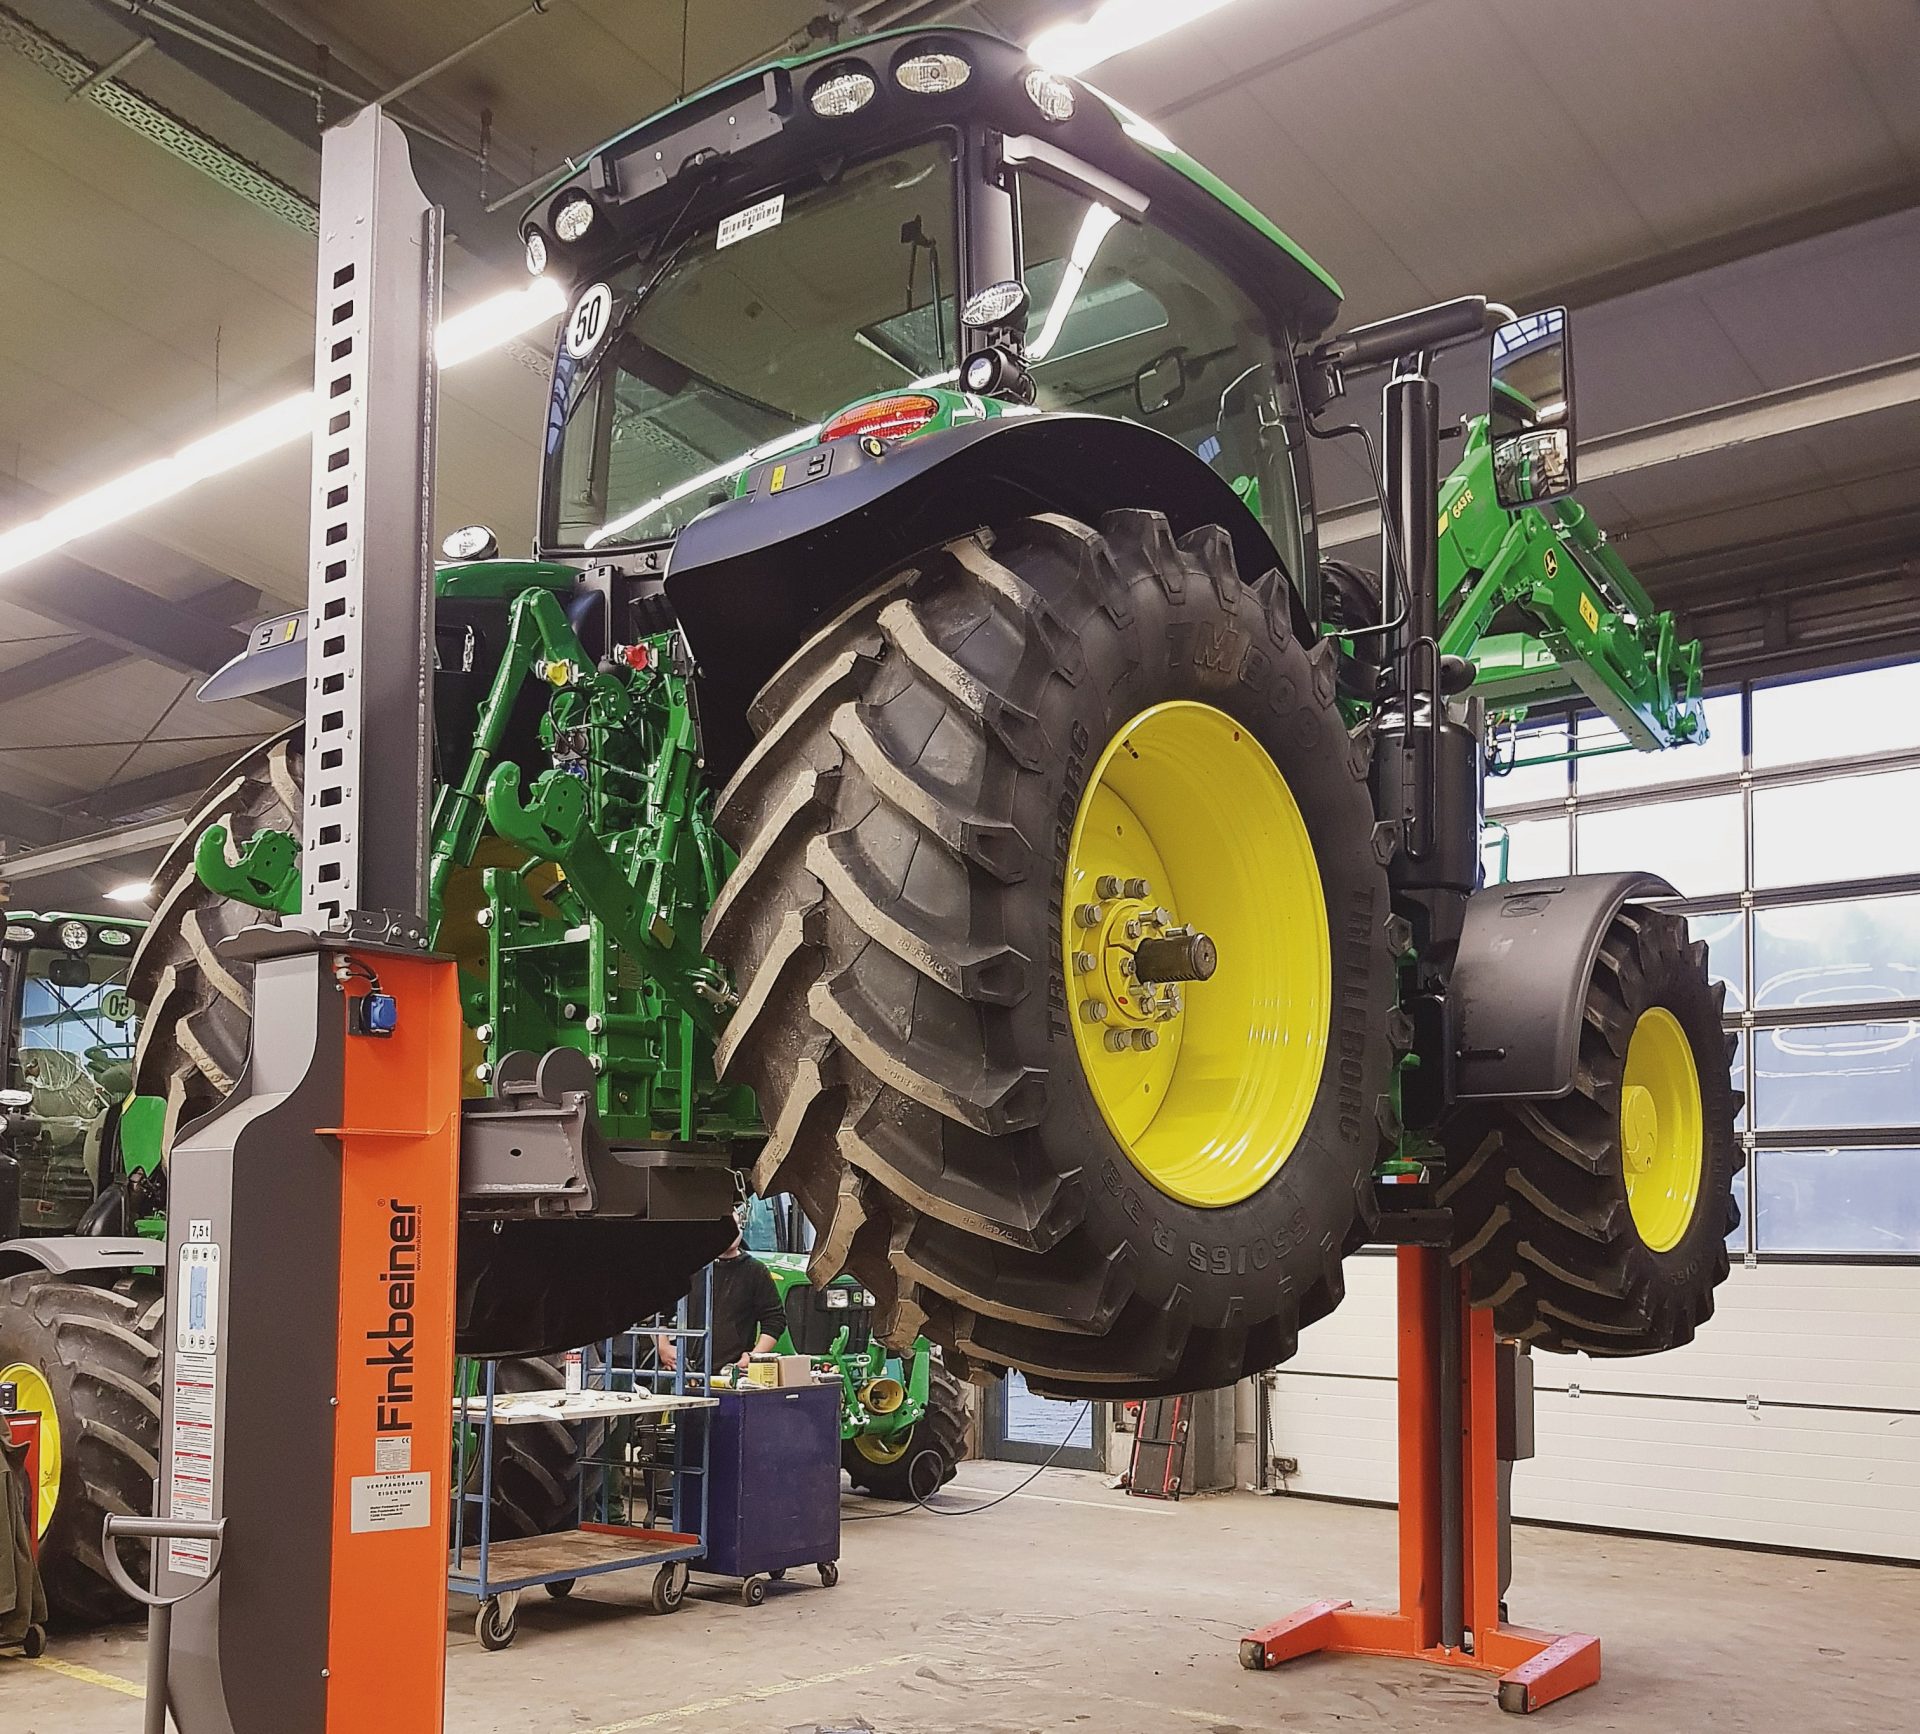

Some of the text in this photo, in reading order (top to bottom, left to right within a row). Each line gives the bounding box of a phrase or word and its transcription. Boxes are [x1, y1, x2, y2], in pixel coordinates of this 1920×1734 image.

[575, 295, 601, 347] 50
[1166, 620, 1323, 748] TM800
[1047, 719, 1089, 1043] TRELLEBORG
[1338, 886, 1376, 1144] TRELLEBORG
[192, 1225, 209, 1239] 7,5 t
[366, 1199, 416, 1431] Finkbeiner
